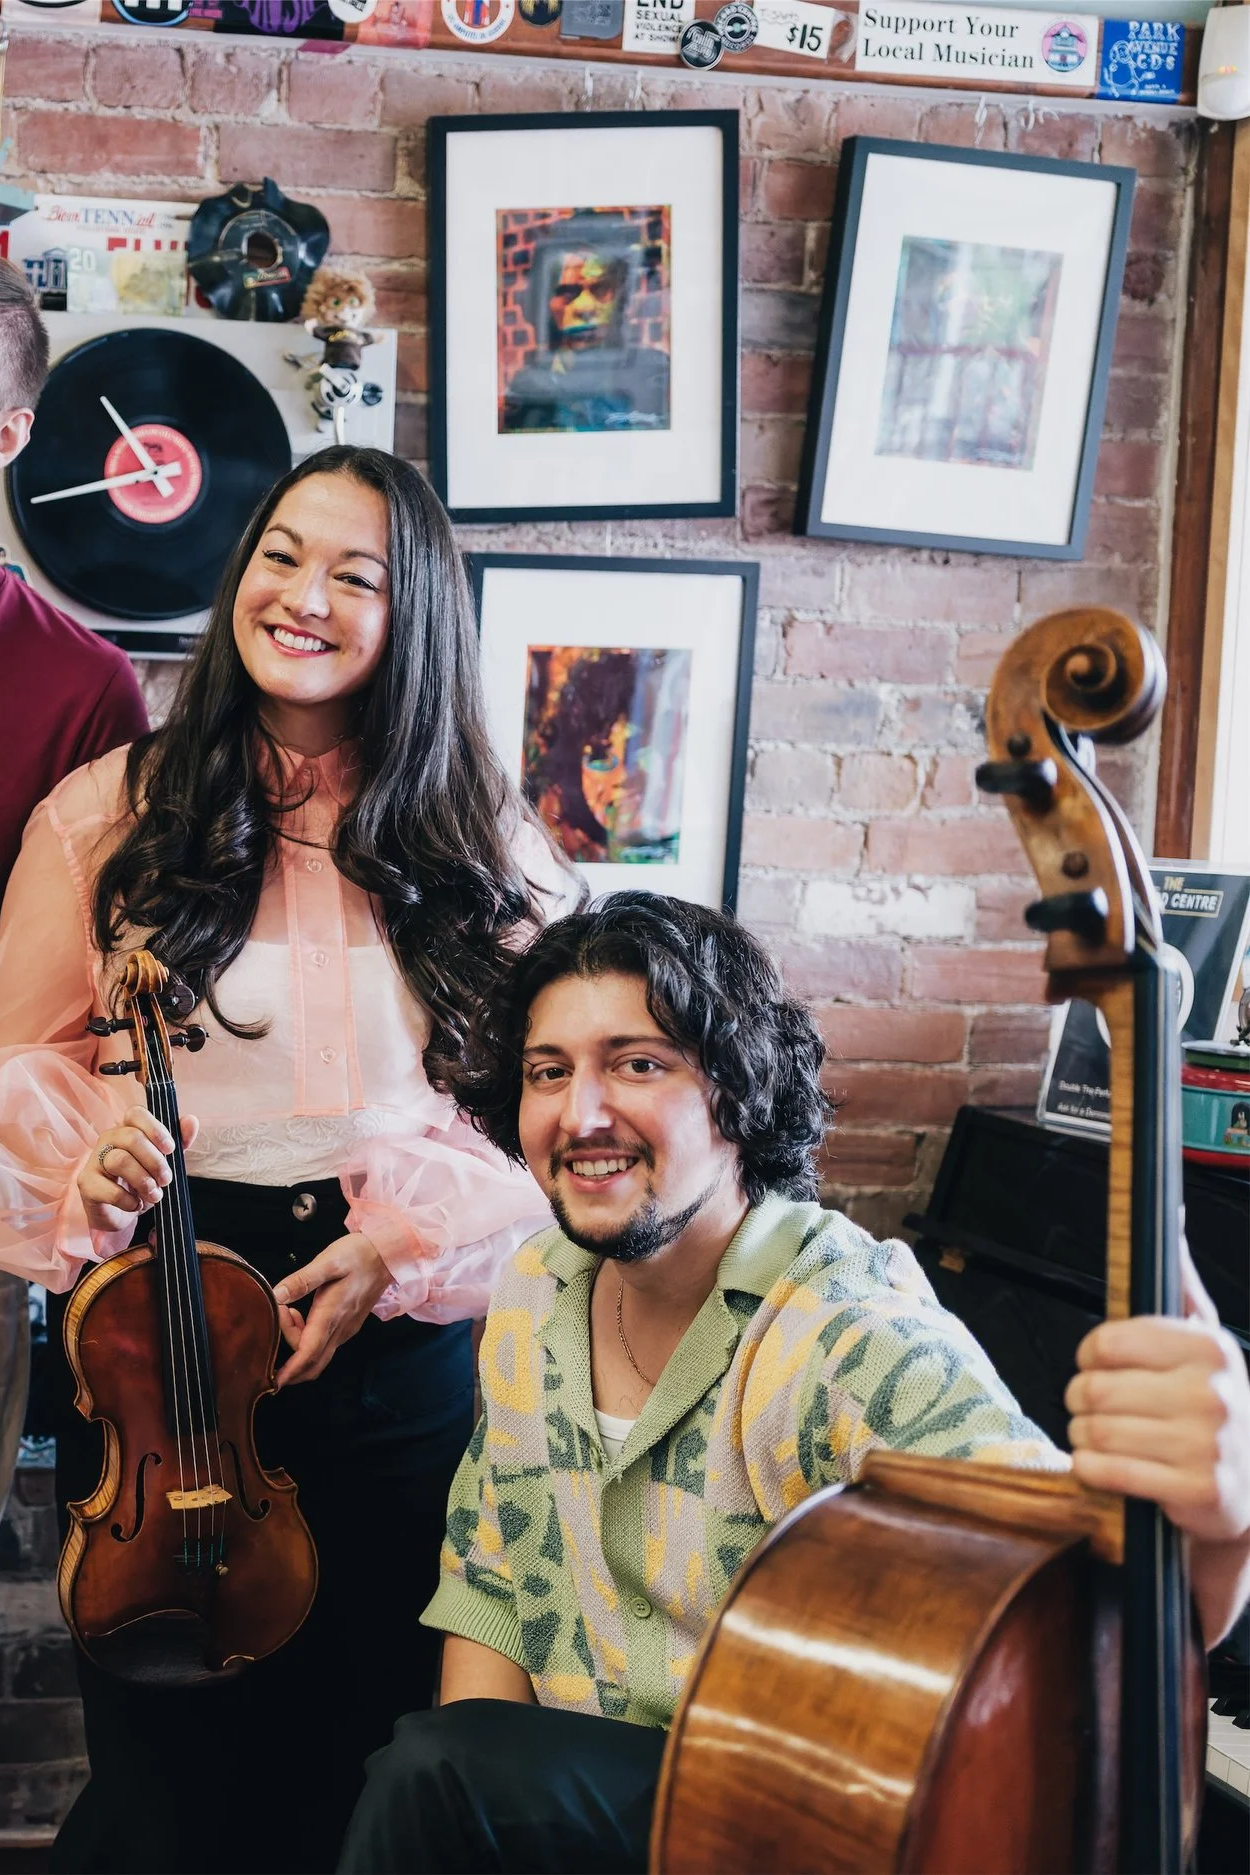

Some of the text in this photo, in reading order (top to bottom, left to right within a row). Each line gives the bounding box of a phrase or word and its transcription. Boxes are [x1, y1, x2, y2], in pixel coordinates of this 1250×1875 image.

[636, 10, 683, 23] SEXUAL
[863, 8, 1019, 39] Support Your
[649, 34, 679, 43] SHOW
[786, 24, 823, 51] $15
[1128, 20, 1181, 41] PARK
[863, 38, 1034, 69] Local Musician
[70, 246, 96, 273] 20
[1163, 876, 1186, 892] THE
[1170, 893, 1219, 911] CENTRE
